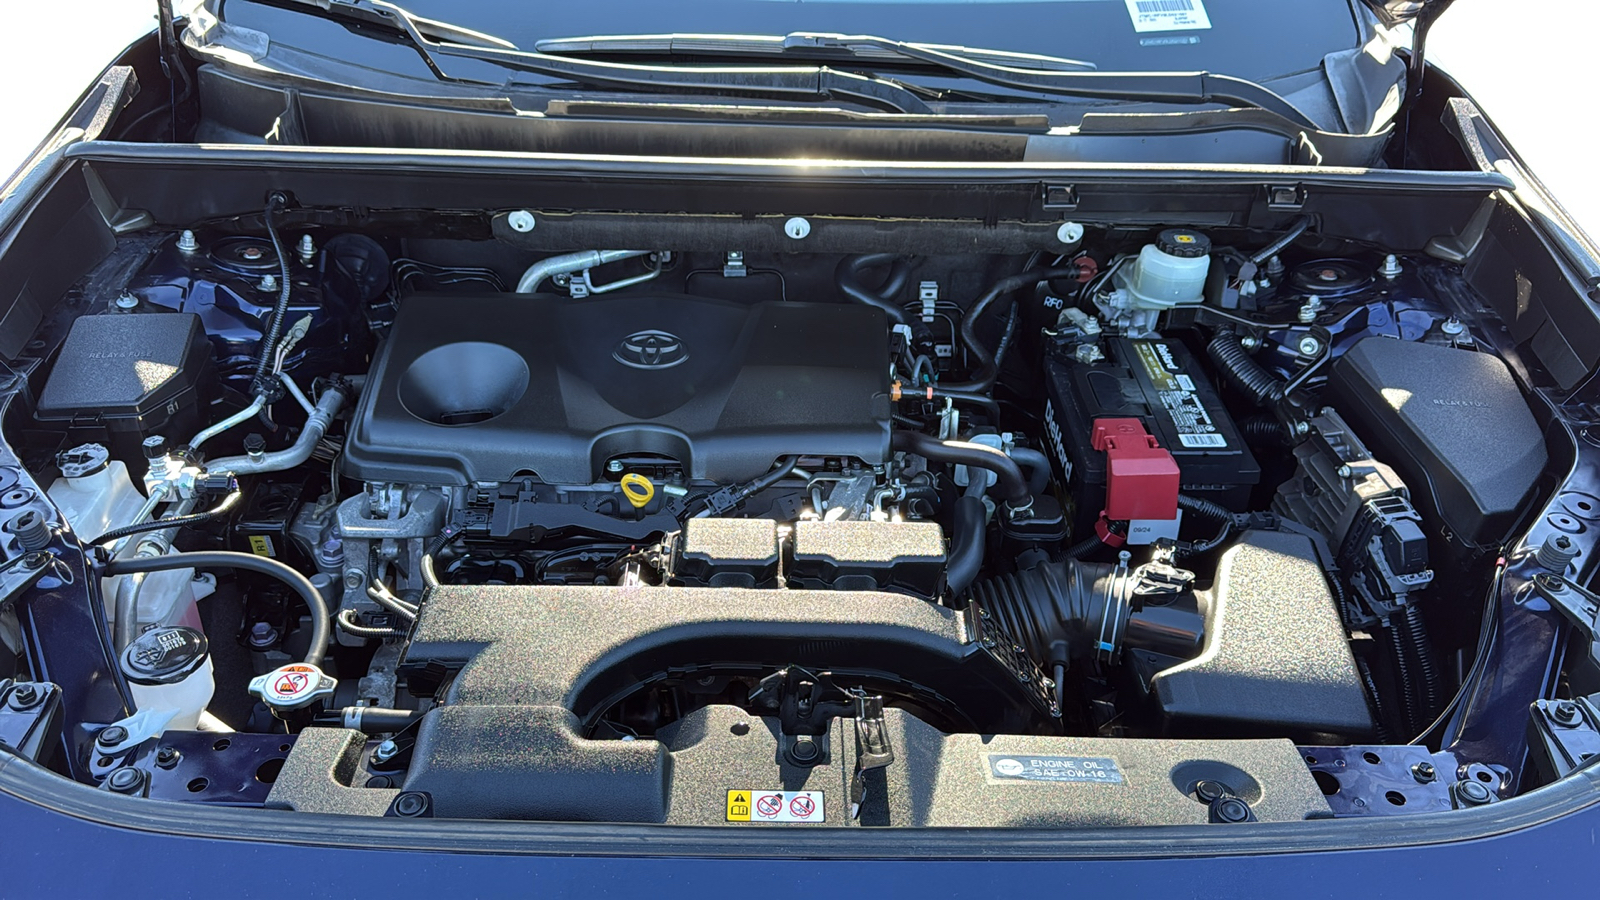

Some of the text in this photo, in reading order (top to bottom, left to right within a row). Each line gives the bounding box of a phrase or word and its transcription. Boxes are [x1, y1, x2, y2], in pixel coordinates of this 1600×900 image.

[128, 351, 153, 359] FUSE
[166, 401, 180, 415] R1
[1045, 398, 1073, 483] DieHard
[1030, 759, 1104, 769] ENGINE OIL
[1034, 768, 1060, 777] SAE
